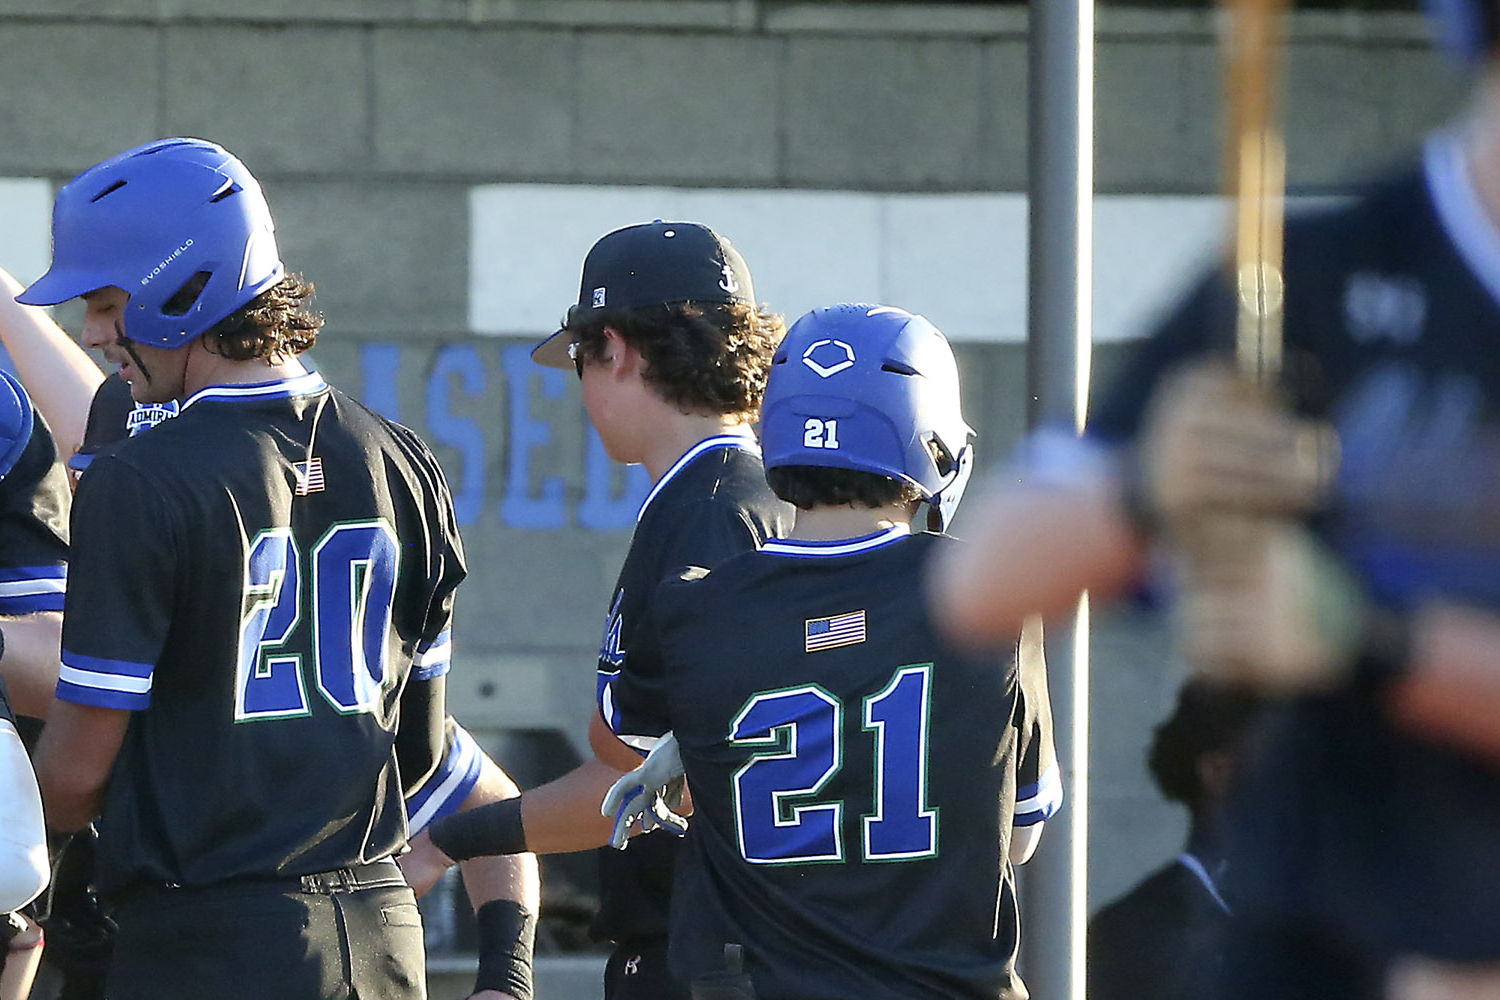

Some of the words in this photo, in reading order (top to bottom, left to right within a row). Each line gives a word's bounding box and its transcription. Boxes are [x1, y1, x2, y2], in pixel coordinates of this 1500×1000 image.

[140, 238, 194, 286] EVOSHIELD
[803, 418, 839, 449] 21
[234, 517, 403, 723] 20
[725, 661, 940, 867] 21
